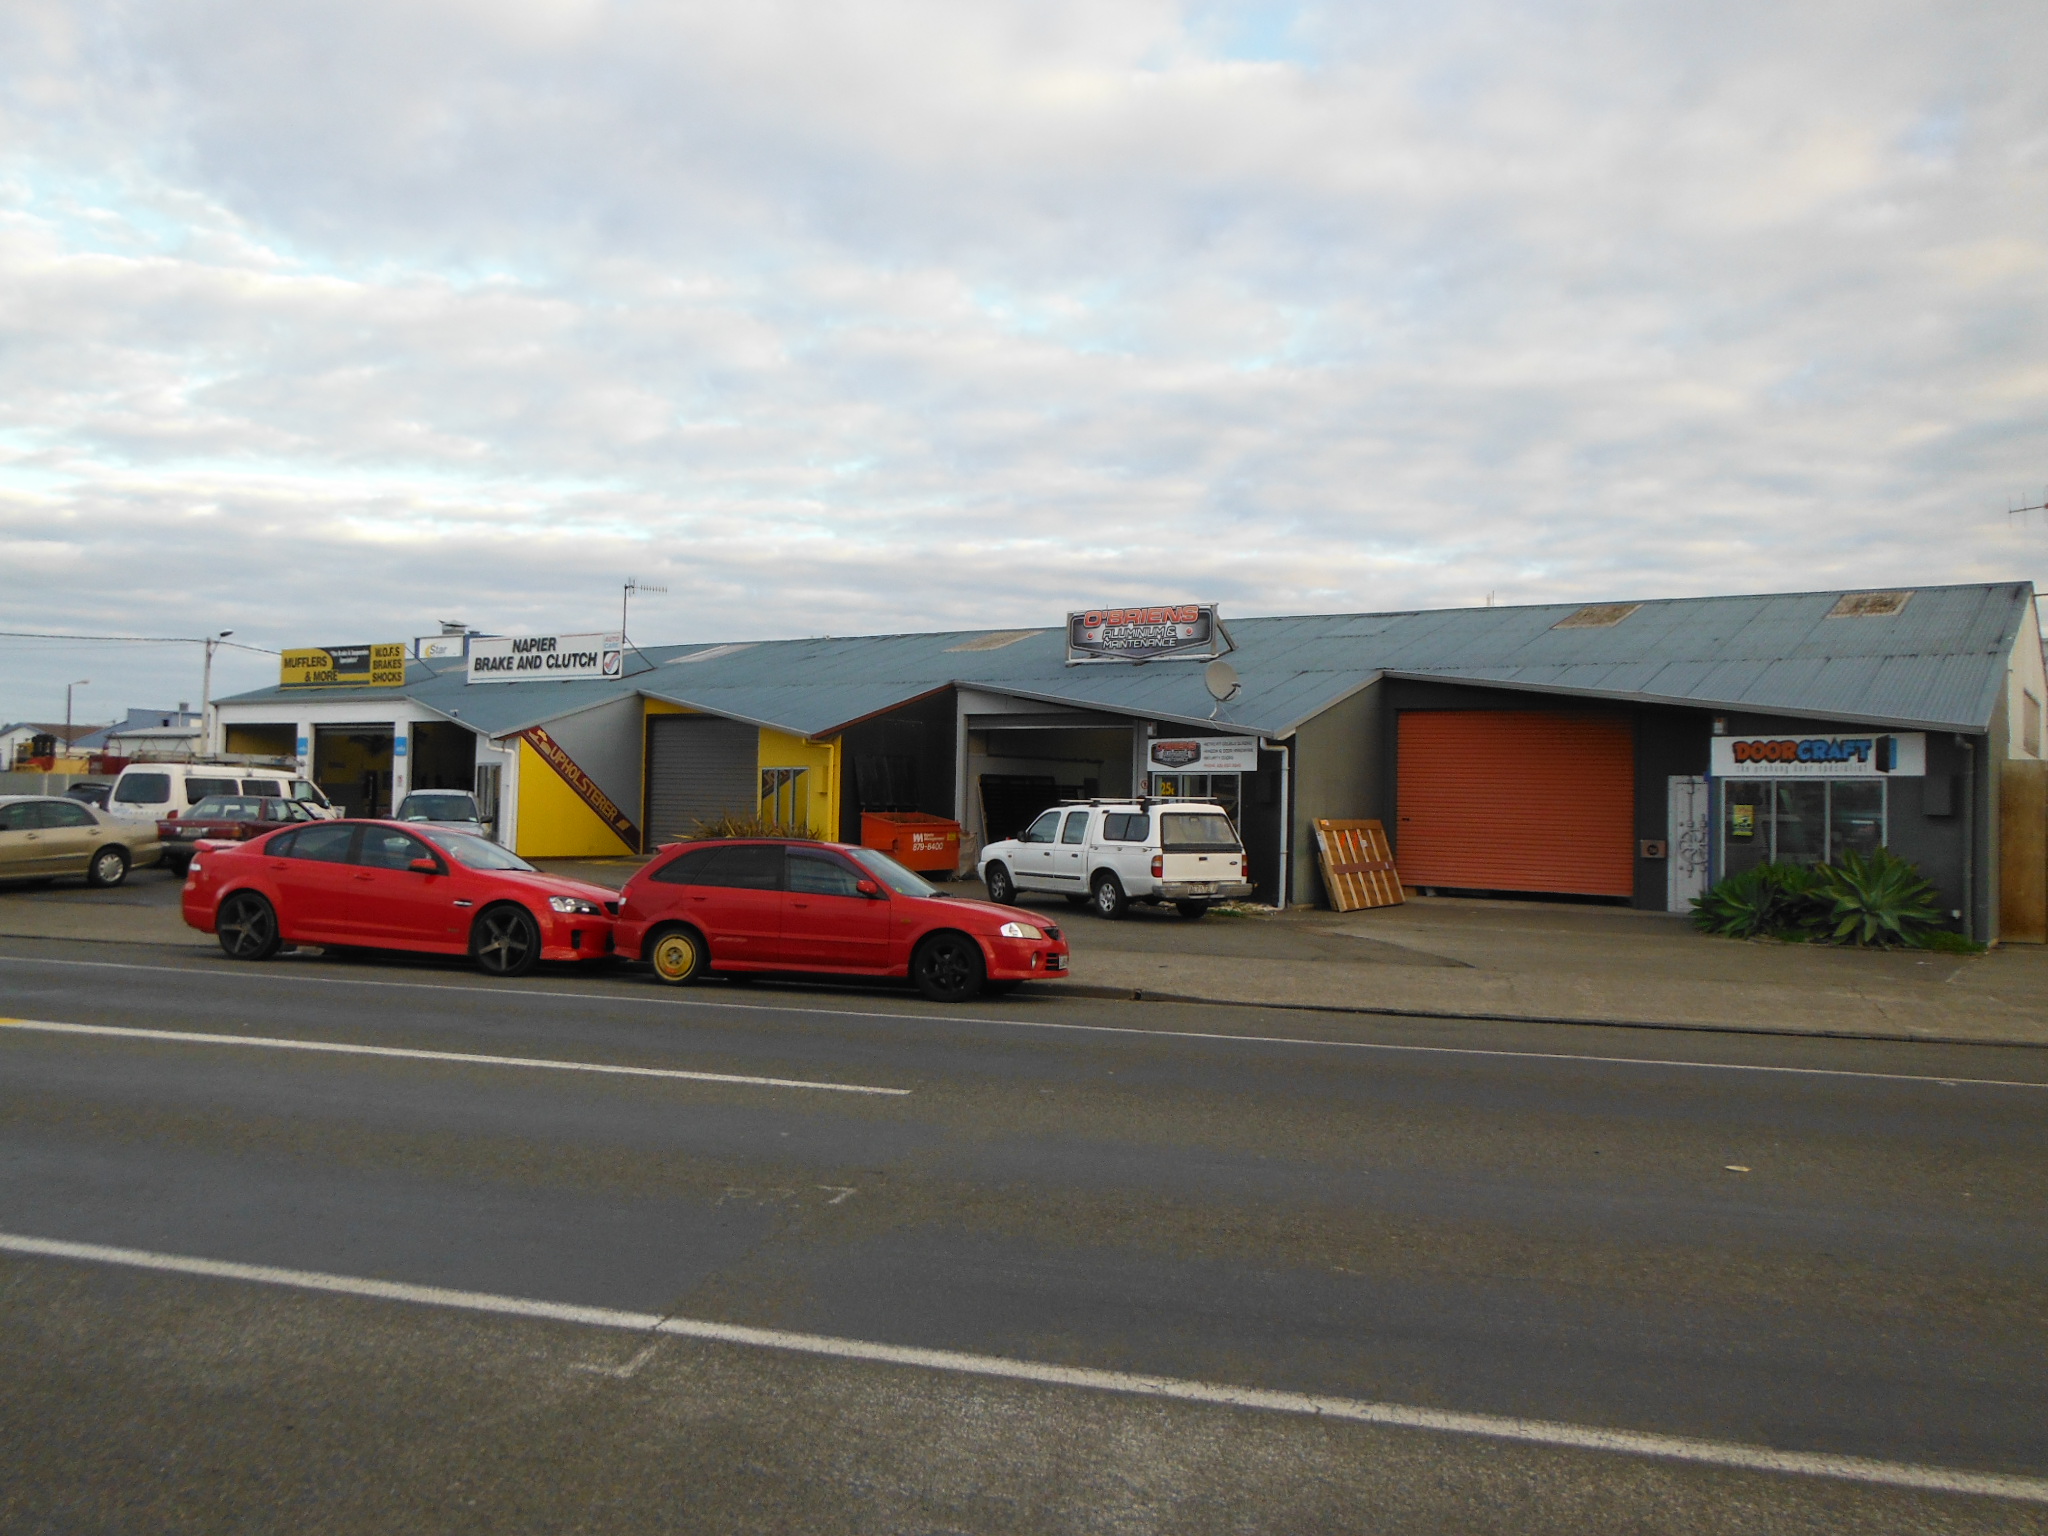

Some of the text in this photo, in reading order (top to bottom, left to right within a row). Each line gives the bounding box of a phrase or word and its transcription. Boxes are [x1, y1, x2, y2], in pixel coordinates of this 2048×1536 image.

[1084, 605, 1199, 627] O'BRIENS
[1102, 626, 1177, 639] ALUMINIUM &
[512, 637, 557, 653] NAPIER
[1102, 638, 1177, 649] MAINTENANCE
[284, 656, 328, 669] MUFFLERS
[373, 660, 402, 670] BRAKES
[474, 652, 598, 671] BRAKE AND CLUTCH
[305, 671, 338, 682] & MORE
[372, 672, 402, 683] SHOCKS
[1732, 737, 1873, 763] DOORCRAFT
[550, 746, 618, 821] UPHOLSTERER
